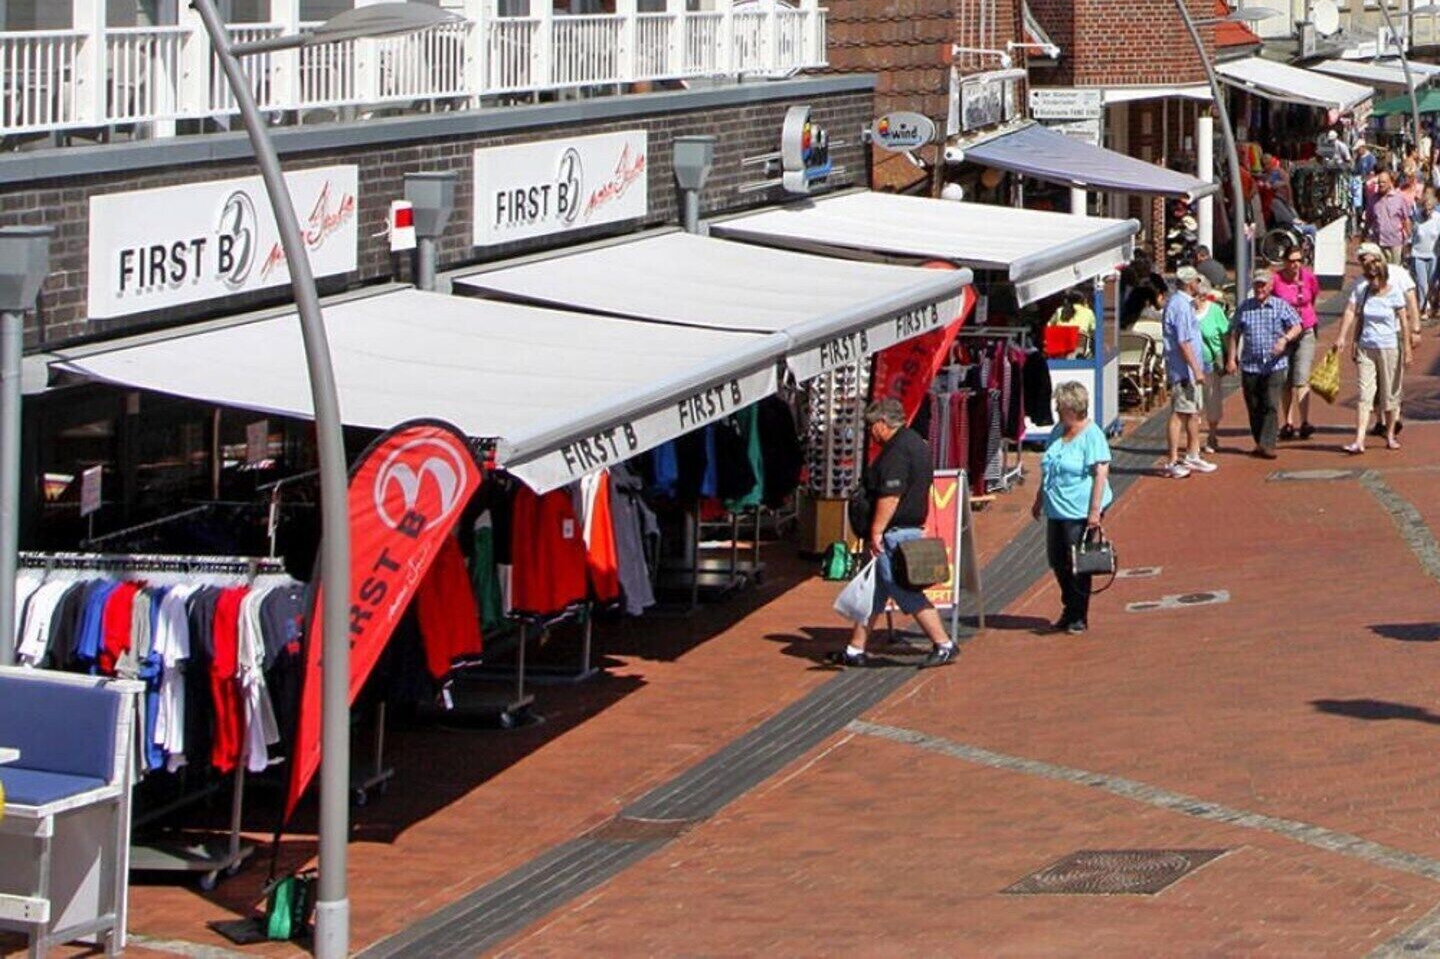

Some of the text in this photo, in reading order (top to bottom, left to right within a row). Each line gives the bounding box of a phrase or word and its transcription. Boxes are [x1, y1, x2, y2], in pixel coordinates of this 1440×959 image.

[496, 181, 569, 225] FIRST B
[118, 234, 235, 292] FIRST B
[895, 306, 928, 339] FIRST
[819, 332, 857, 369] FIRST
[678, 379, 742, 429] FIRST B
[560, 422, 639, 475] FIRST B
